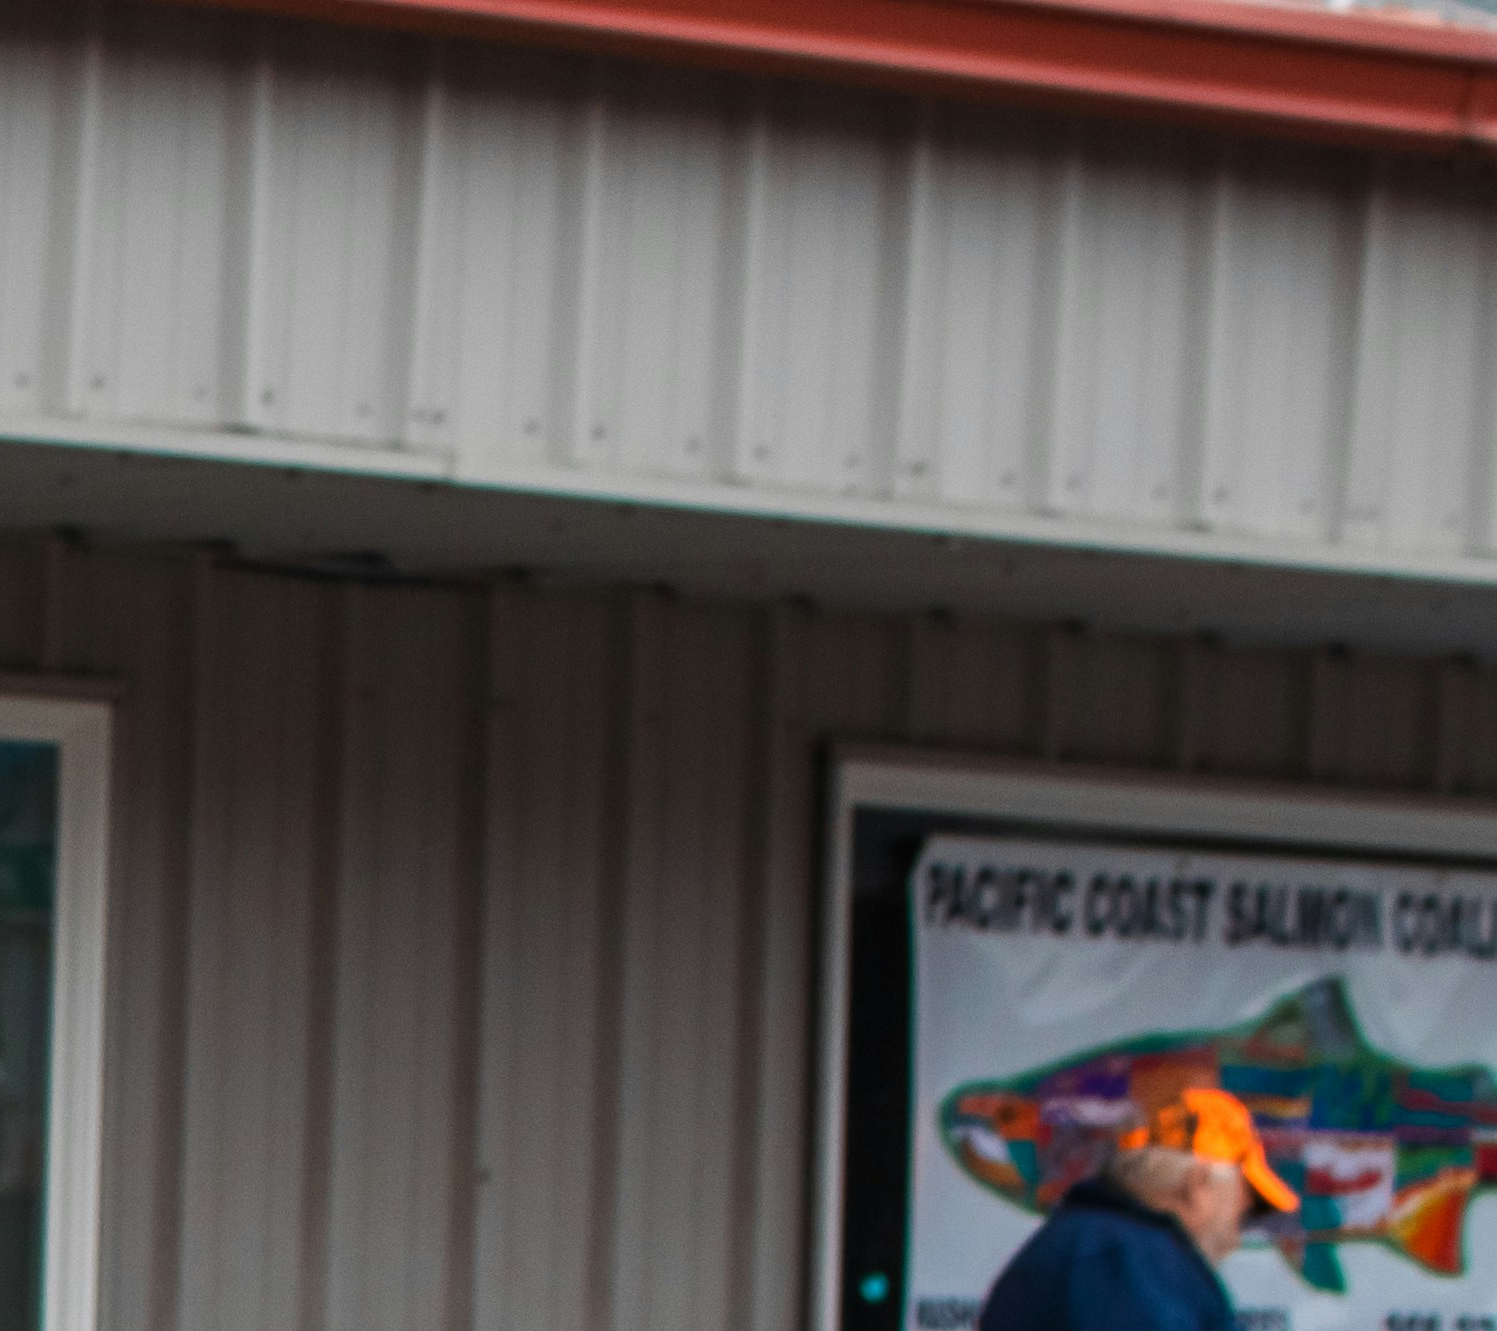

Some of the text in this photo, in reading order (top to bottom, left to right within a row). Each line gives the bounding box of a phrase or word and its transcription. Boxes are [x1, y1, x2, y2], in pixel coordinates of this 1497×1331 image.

[924, 861, 1075, 935] PACIFIC
[1084, 870, 1218, 943] COAST
[1222, 879, 1386, 954] SALMON
